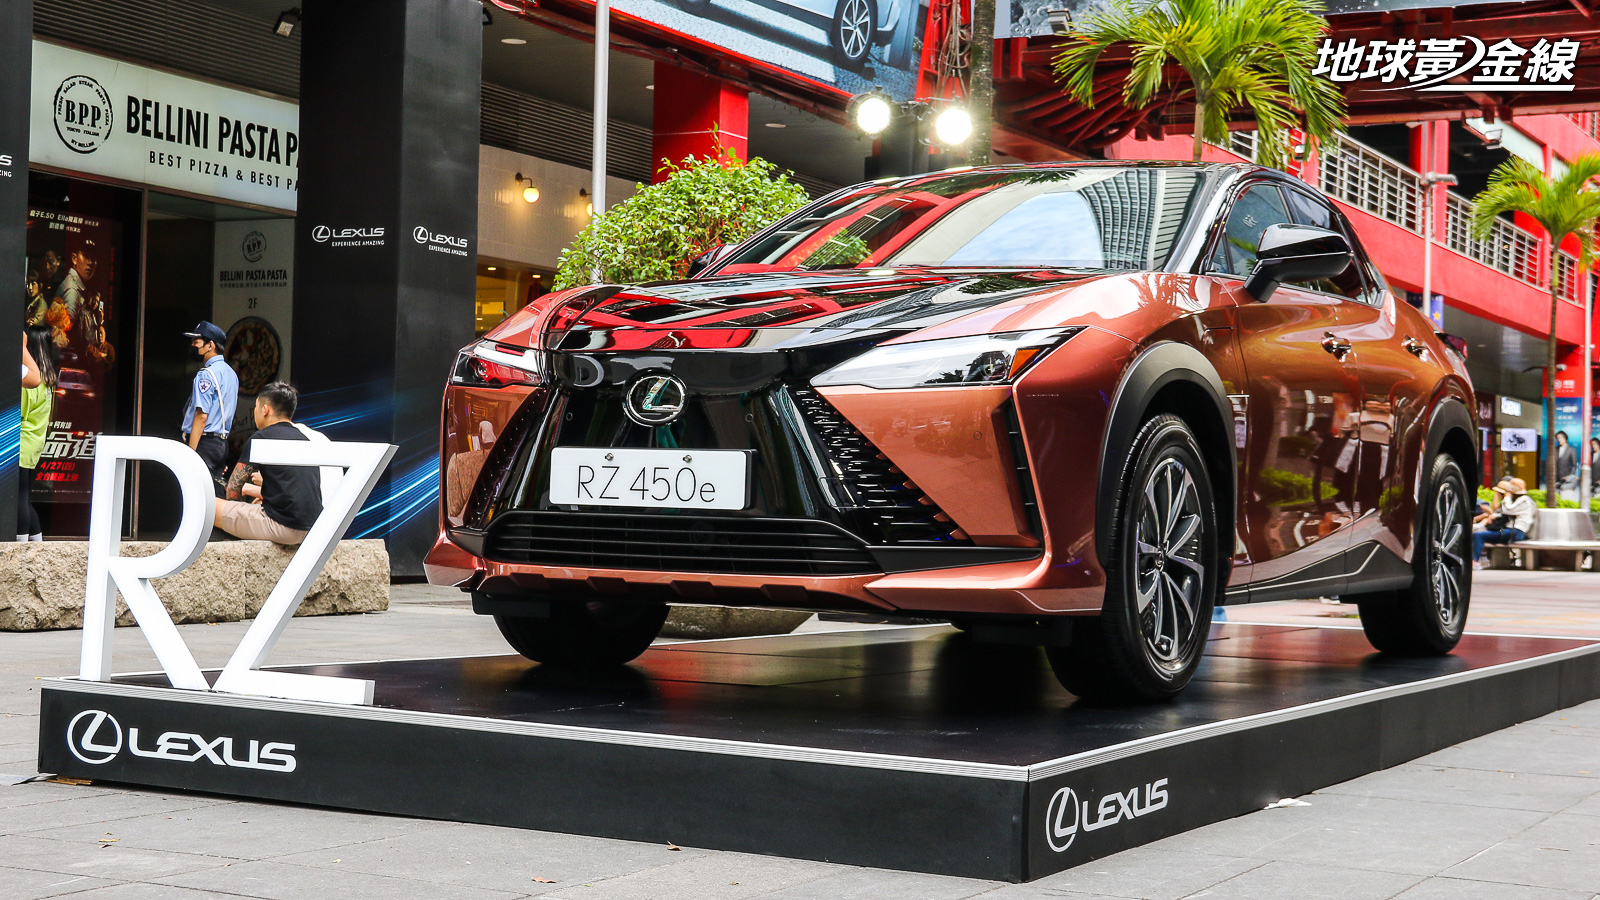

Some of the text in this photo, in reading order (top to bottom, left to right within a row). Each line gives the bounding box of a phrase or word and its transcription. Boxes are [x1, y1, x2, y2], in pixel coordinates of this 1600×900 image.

[65, 99, 102, 129] B.P.P.
[126, 95, 209, 149] BELLINI
[218, 115, 281, 165] PASTA
[149, 150, 182, 169] BEST
[189, 158, 228, 178] PIZZA
[236, 169, 243, 181] &
[250, 170, 280, 188] BEST
[332, 227, 385, 238] LEXUS
[429, 232, 468, 248] LEXUS
[428, 244, 468, 257] EXPERIENCE AMAZING
[220, 269, 288, 281] BELLINI PASTA PASTA
[248, 297, 258, 309] 2F
[577, 465, 716, 503] RZ 450e
[80, 434, 399, 706] RZ
[129, 727, 297, 773] LEXUS
[1082, 777, 1169, 832] LEXUS
